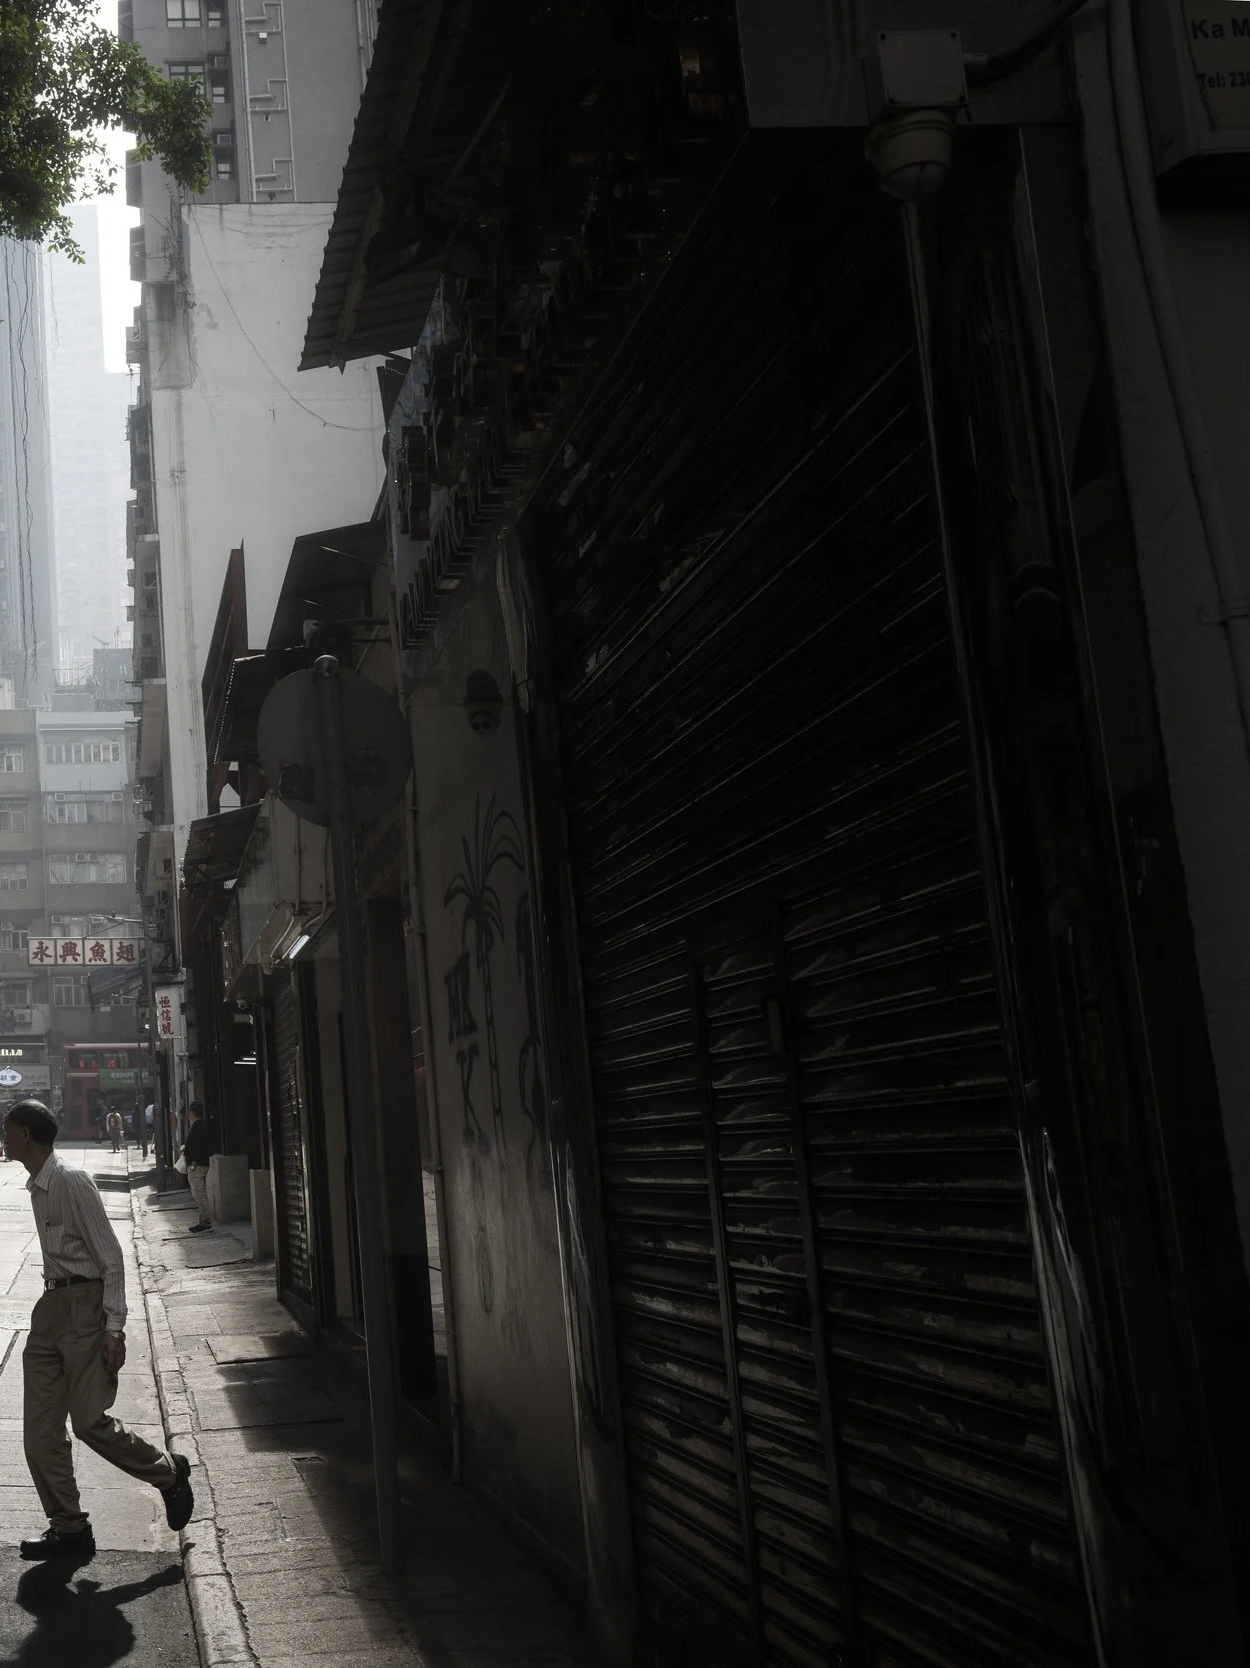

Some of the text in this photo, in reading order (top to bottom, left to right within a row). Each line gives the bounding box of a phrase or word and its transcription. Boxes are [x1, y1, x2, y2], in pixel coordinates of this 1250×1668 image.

[1191, 18, 1225, 39] Ka
[1197, 71, 1226, 89] Tel:
[31, 940, 136, 963] 永興魚翅
